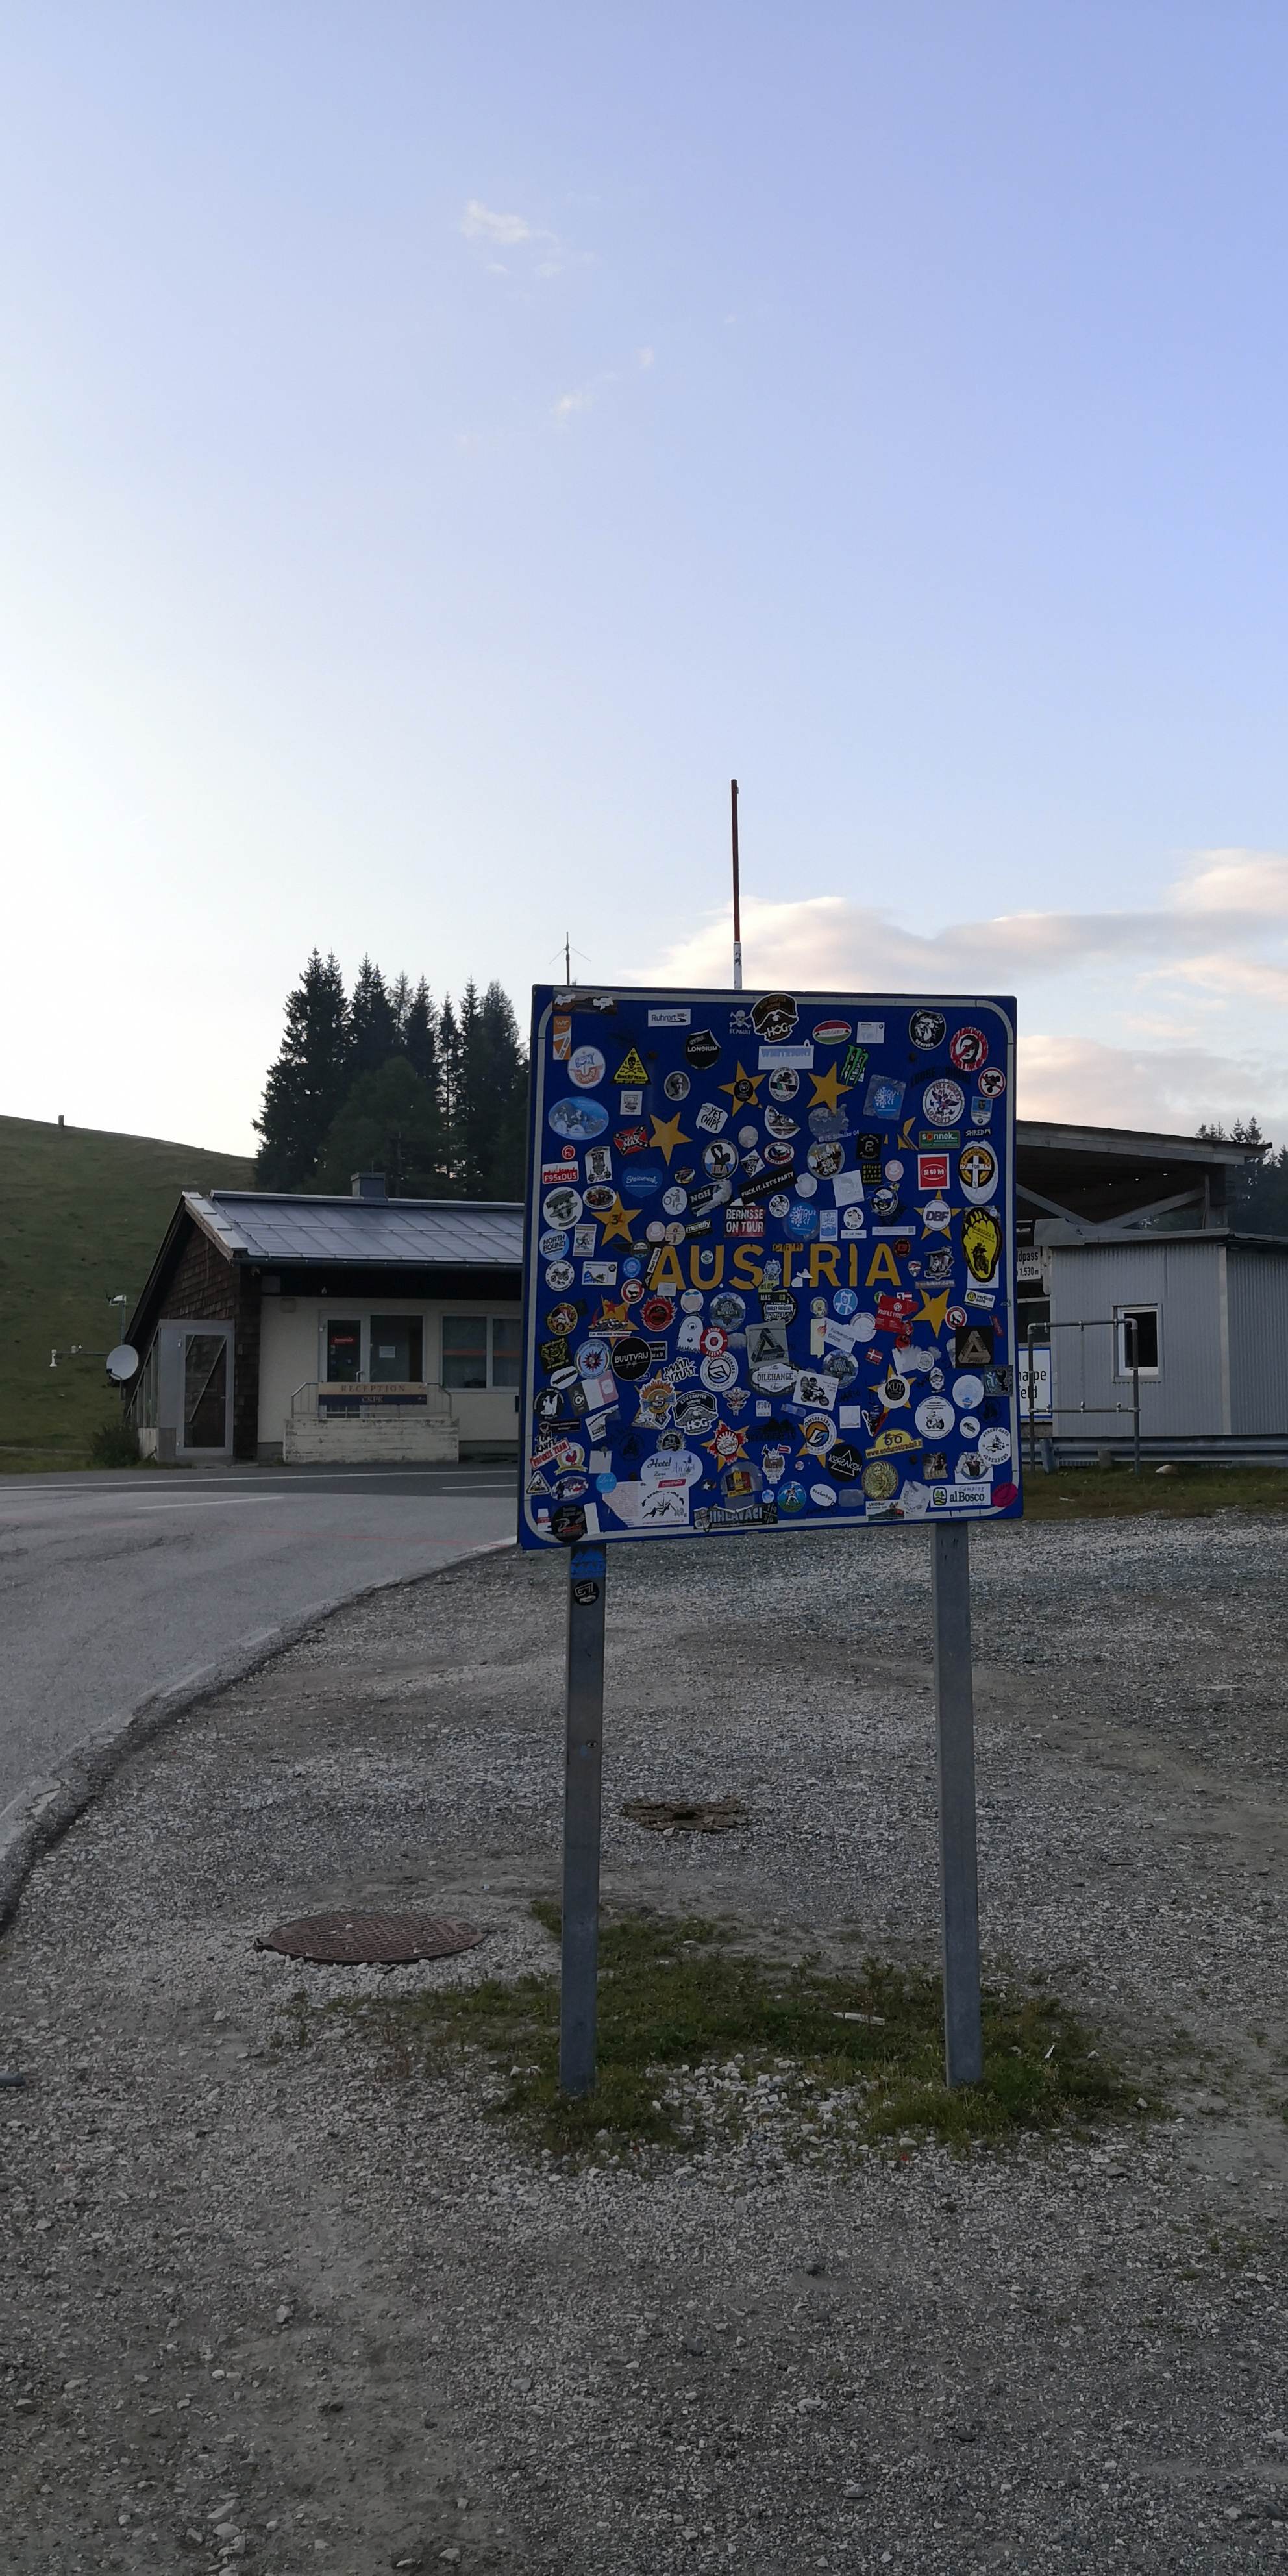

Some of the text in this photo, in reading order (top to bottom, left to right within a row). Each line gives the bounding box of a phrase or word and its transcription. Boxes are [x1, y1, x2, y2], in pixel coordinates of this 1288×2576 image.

[708, 1106, 723, 1121] YES
[700, 1114, 721, 1131] CHIPS
[726, 1208, 764, 1220] BERNISSE
[726, 1221, 764, 1233] ON TOUR
[649, 1243, 902, 1290] AUSTRIA
[647, 1456, 672, 1468] Hotel
